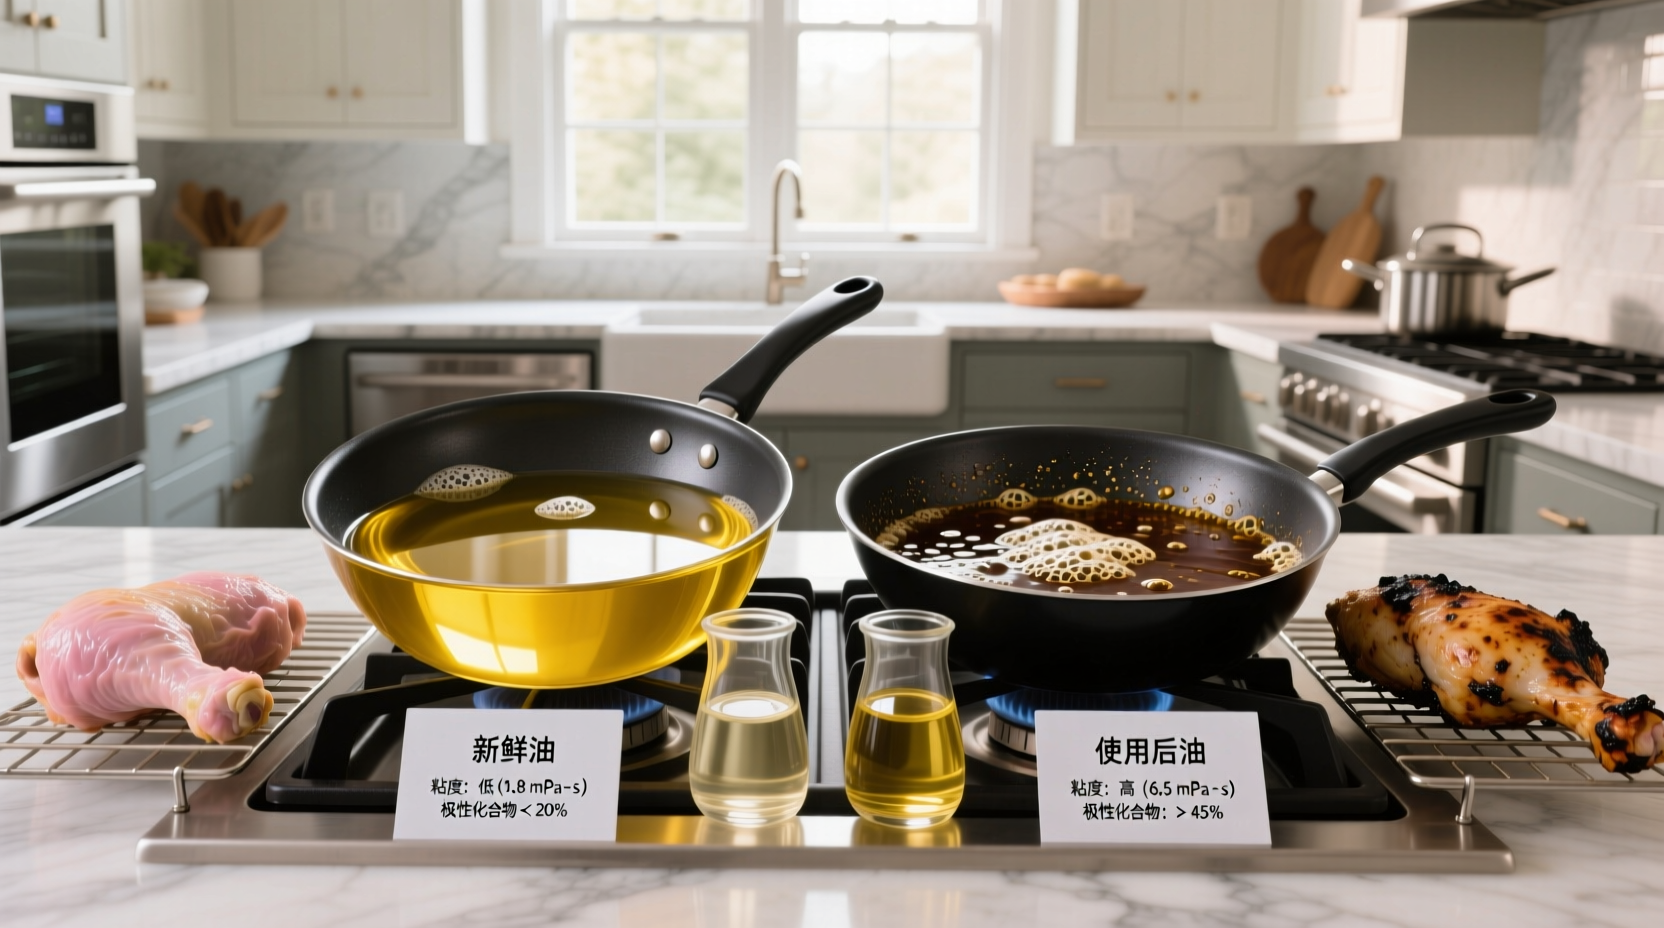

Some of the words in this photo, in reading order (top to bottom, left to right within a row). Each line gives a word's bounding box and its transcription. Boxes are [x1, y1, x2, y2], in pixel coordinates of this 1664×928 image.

[471, 734, 555, 764] 新鲜油
[1094, 735, 1206, 766] 使用后油
[478, 778, 494, 796] 低
[497, 778, 526, 796] (1.8
[1118, 779, 1135, 797] 高
[1142, 779, 1173, 800] (6.5
[440, 800, 518, 819] 极性化合物
[535, 802, 568, 818] 20%
[1190, 804, 1224, 820] 45%
